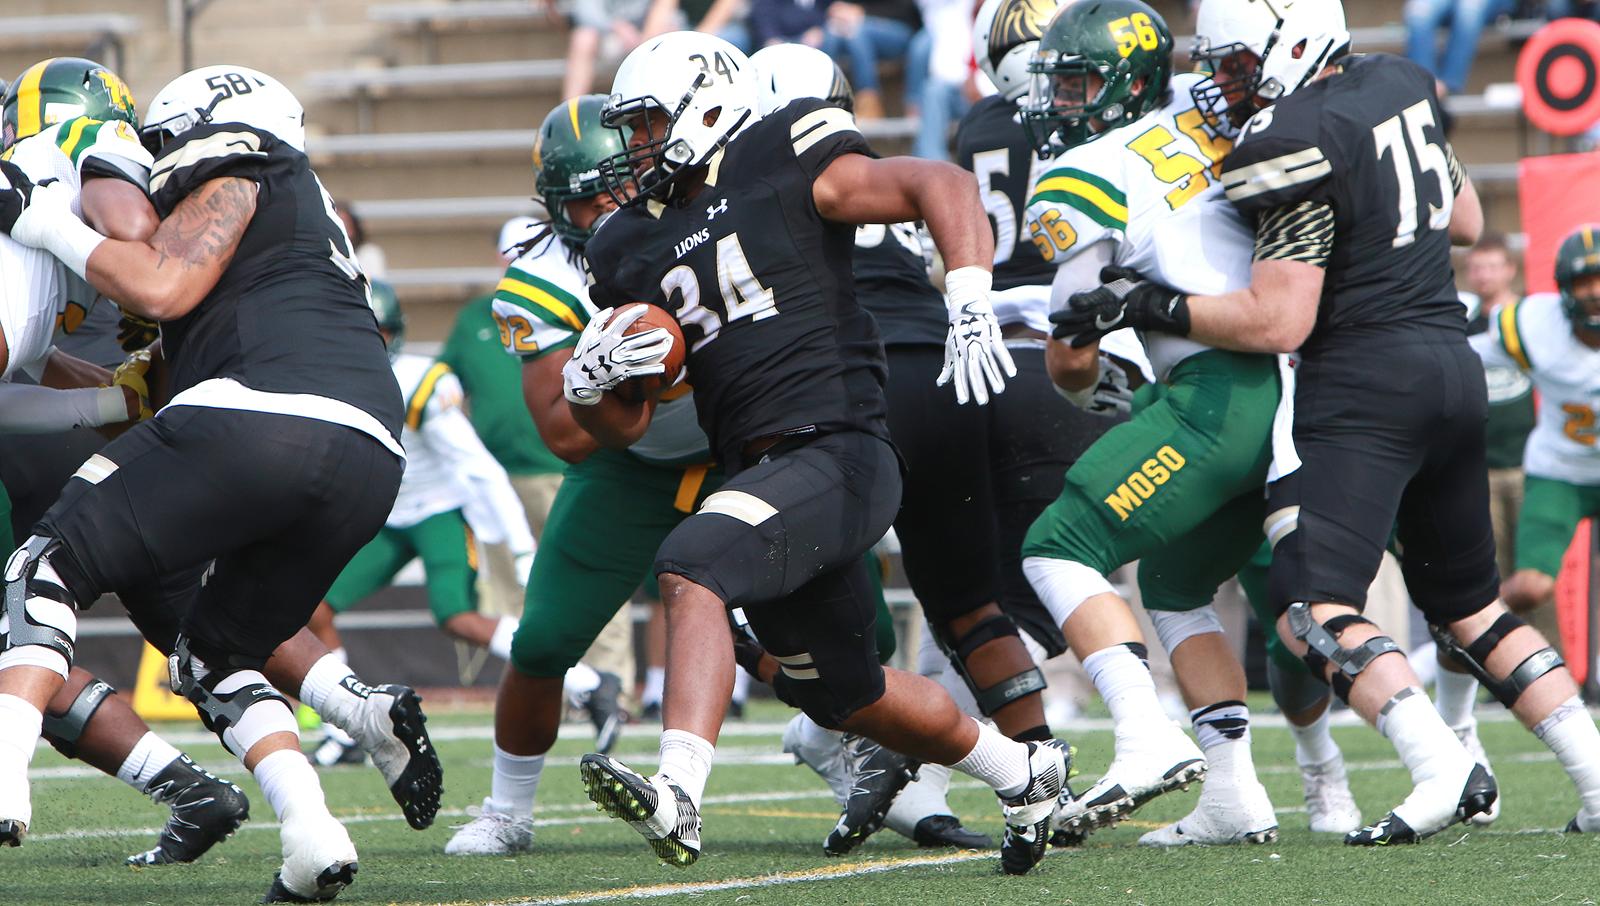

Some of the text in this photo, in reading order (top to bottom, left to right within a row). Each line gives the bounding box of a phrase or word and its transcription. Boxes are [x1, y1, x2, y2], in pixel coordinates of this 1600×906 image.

[1107, 12, 1159, 58] 56
[205, 72, 252, 101] 58
[688, 51, 734, 88] 34
[1372, 98, 1455, 248] 75
[673, 227, 711, 260] LIONS
[1029, 208, 1078, 262] 56
[660, 231, 781, 354] 34
[1103, 444, 1187, 522] MOSO
